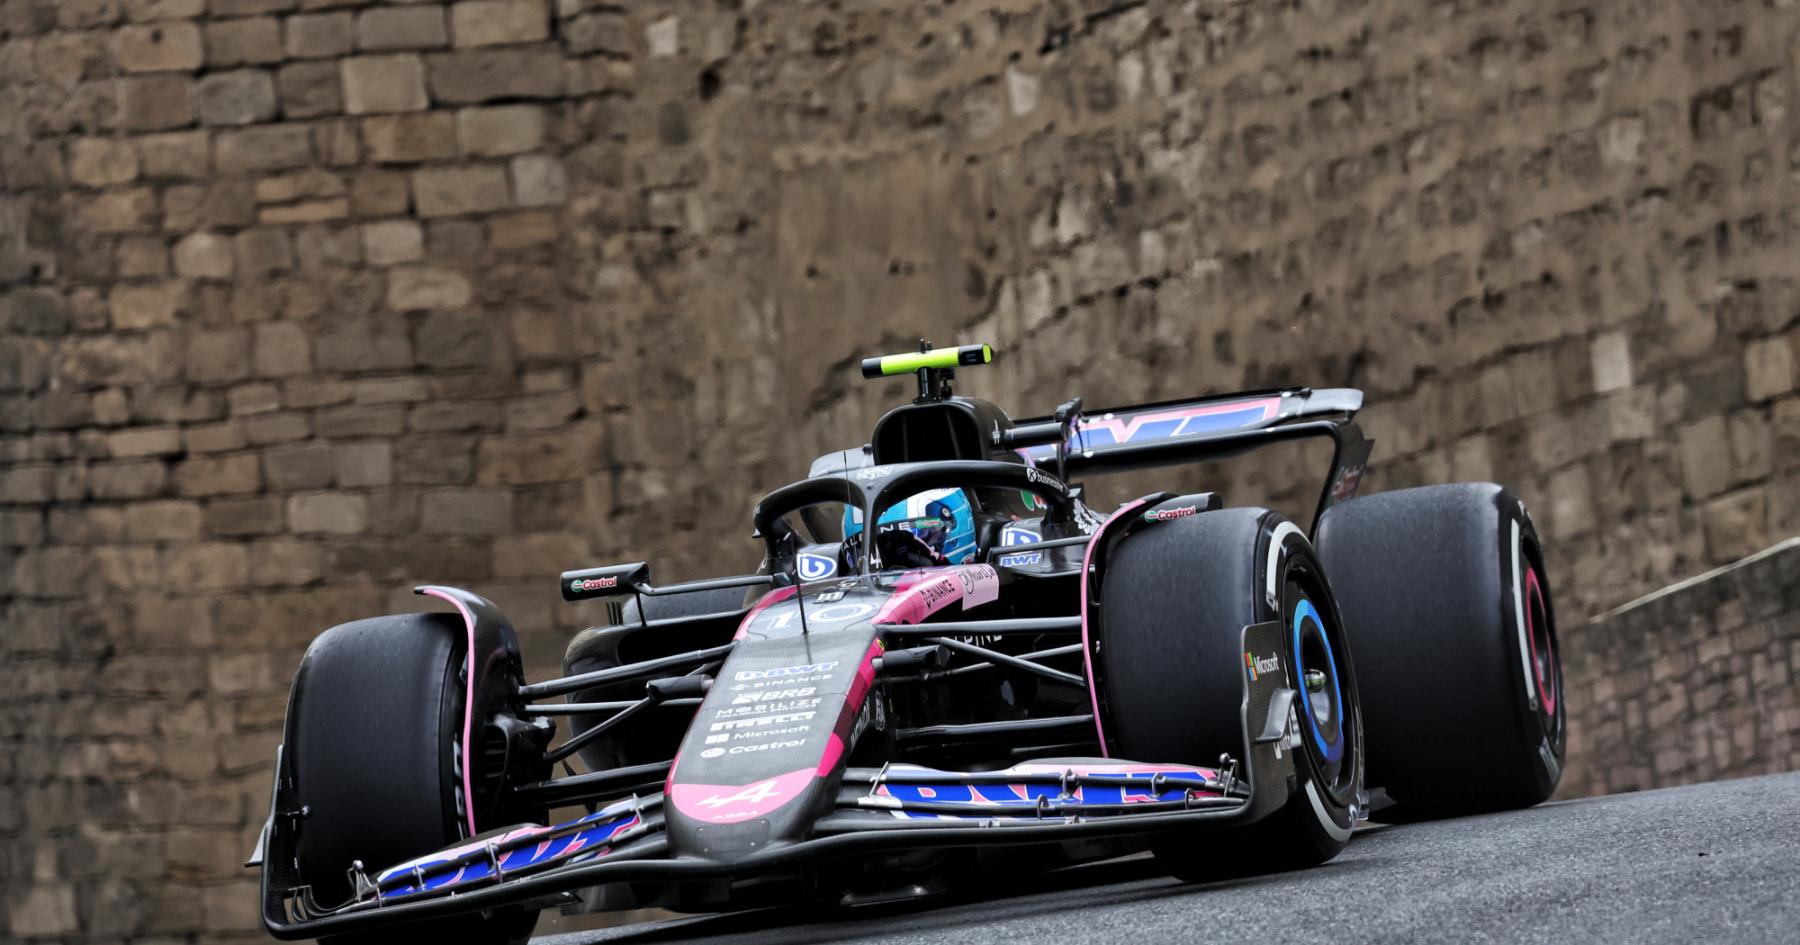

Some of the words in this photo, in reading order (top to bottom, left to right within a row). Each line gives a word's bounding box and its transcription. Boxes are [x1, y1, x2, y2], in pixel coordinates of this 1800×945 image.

[1158, 506, 1196, 520] Castrol
[1000, 553, 1041, 567] BWT
[582, 576, 617, 590] Castrol
[928, 579, 955, 602] BINANCE
[1253, 651, 1280, 675] Microsoft
[754, 674, 833, 687] BINANCE
[761, 687, 817, 701] BRB
[734, 725, 811, 740] Microsoft
[729, 738, 806, 754] Castrol
